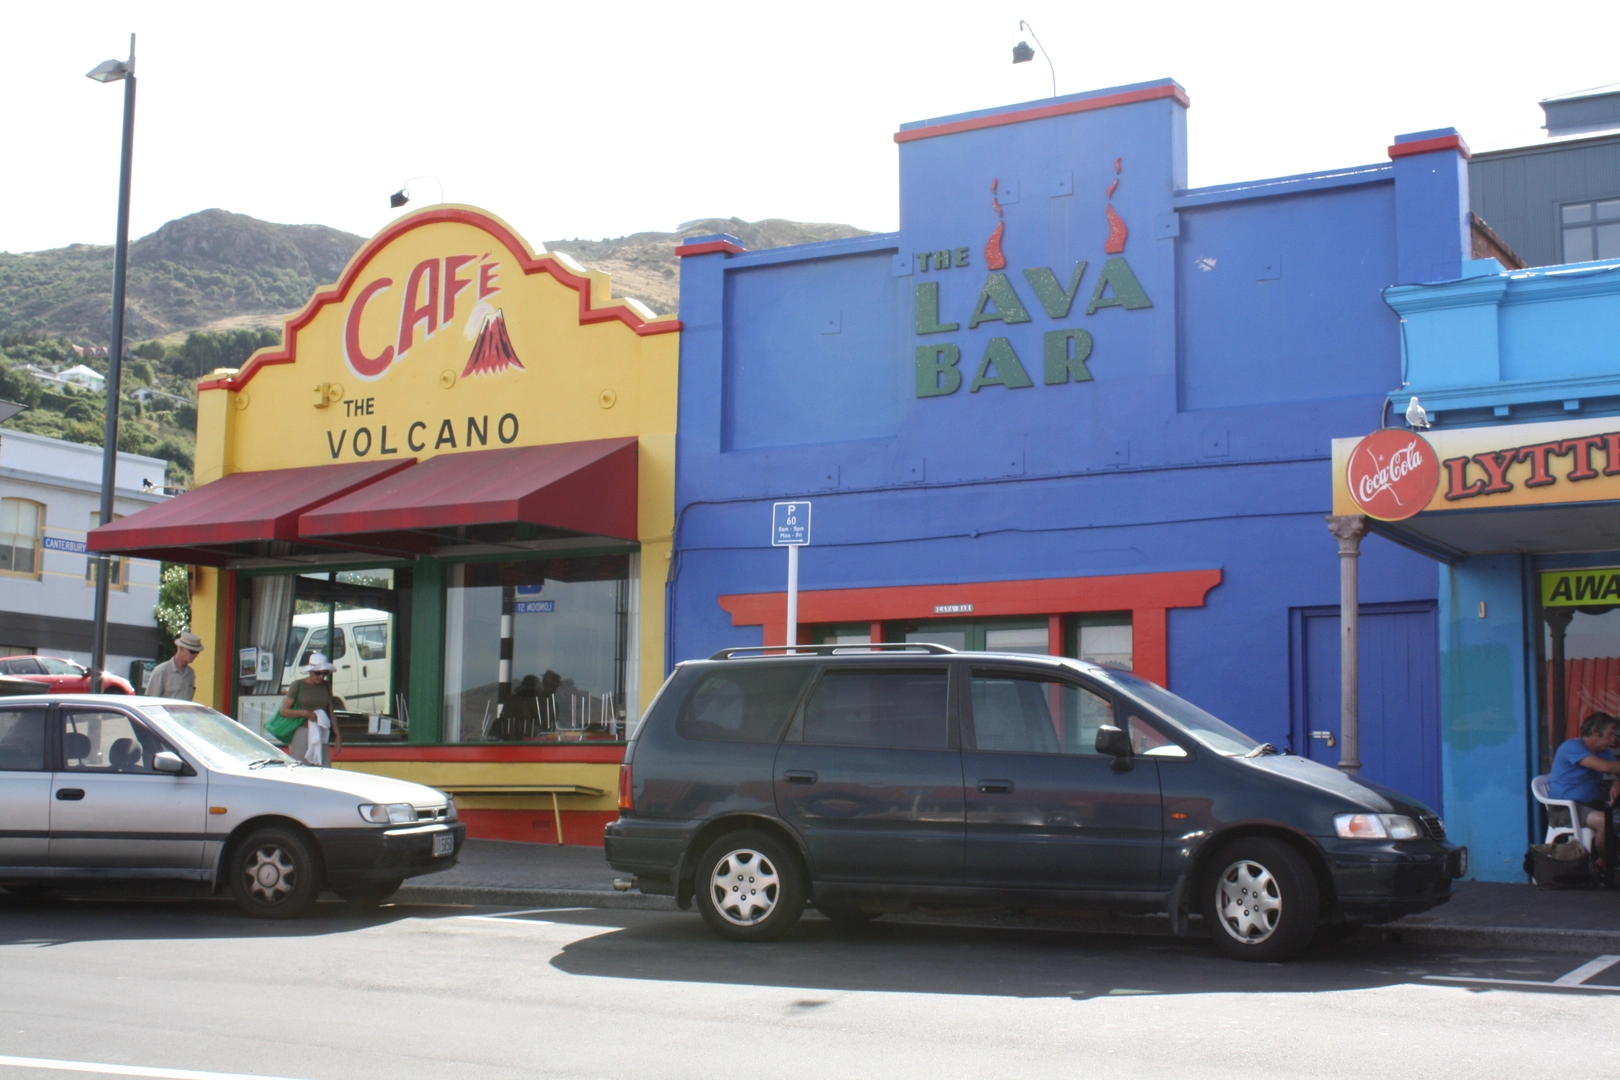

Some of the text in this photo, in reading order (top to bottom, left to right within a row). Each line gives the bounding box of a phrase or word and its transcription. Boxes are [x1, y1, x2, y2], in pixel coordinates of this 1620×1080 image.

[916, 247, 969, 272] THE
[915, 257, 1153, 336] LAVA
[343, 251, 502, 380] CAFÉ
[915, 328, 1094, 399] BAR
[343, 397, 375, 418] THE
[326, 412, 519, 460] VOLCANO
[786, 516, 797, 526] 60
[787, 505, 796, 516] P
[45, 538, 87, 552] CANTERBURY
